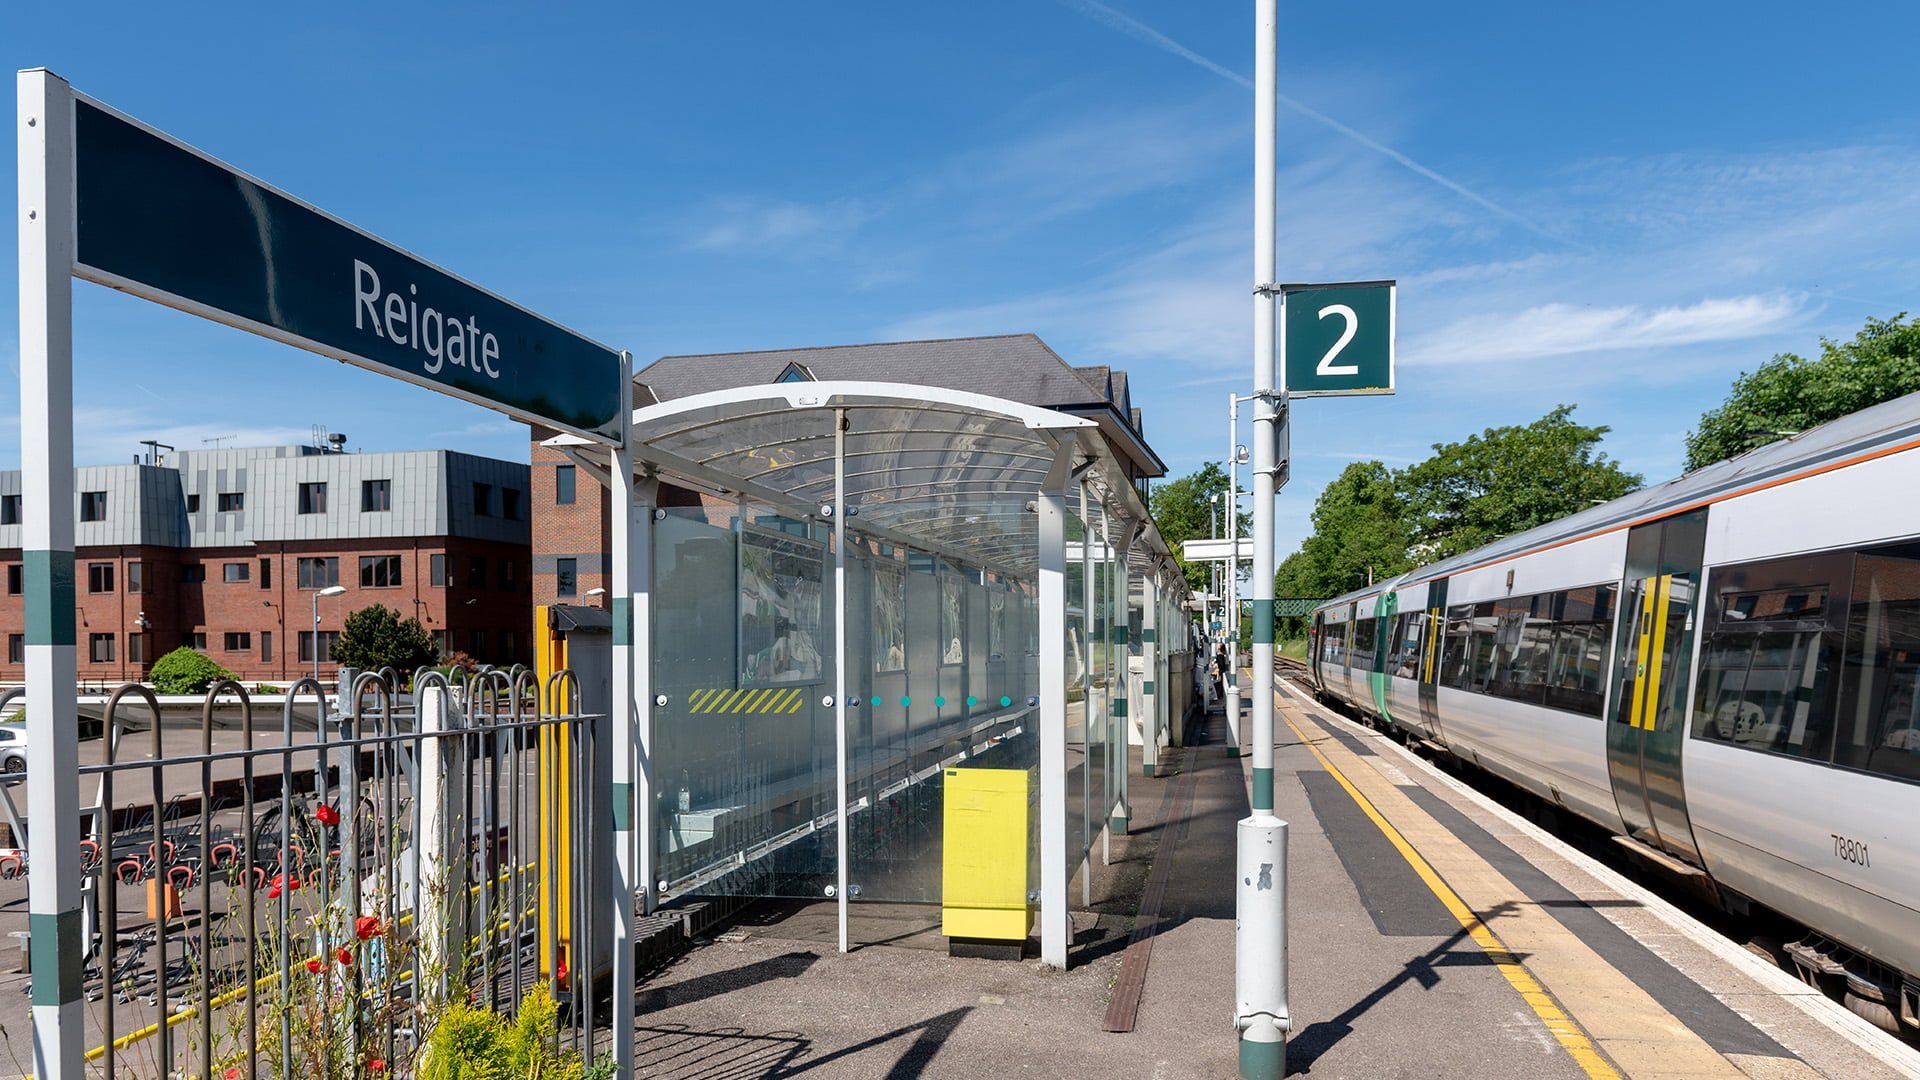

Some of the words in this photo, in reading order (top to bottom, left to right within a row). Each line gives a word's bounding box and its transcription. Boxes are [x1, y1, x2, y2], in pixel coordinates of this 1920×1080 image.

[354, 258, 500, 379] Reigate
[1316, 304, 1359, 376] 2
[1219, 606, 1225, 616] 2
[1831, 833, 1870, 868] 78801
